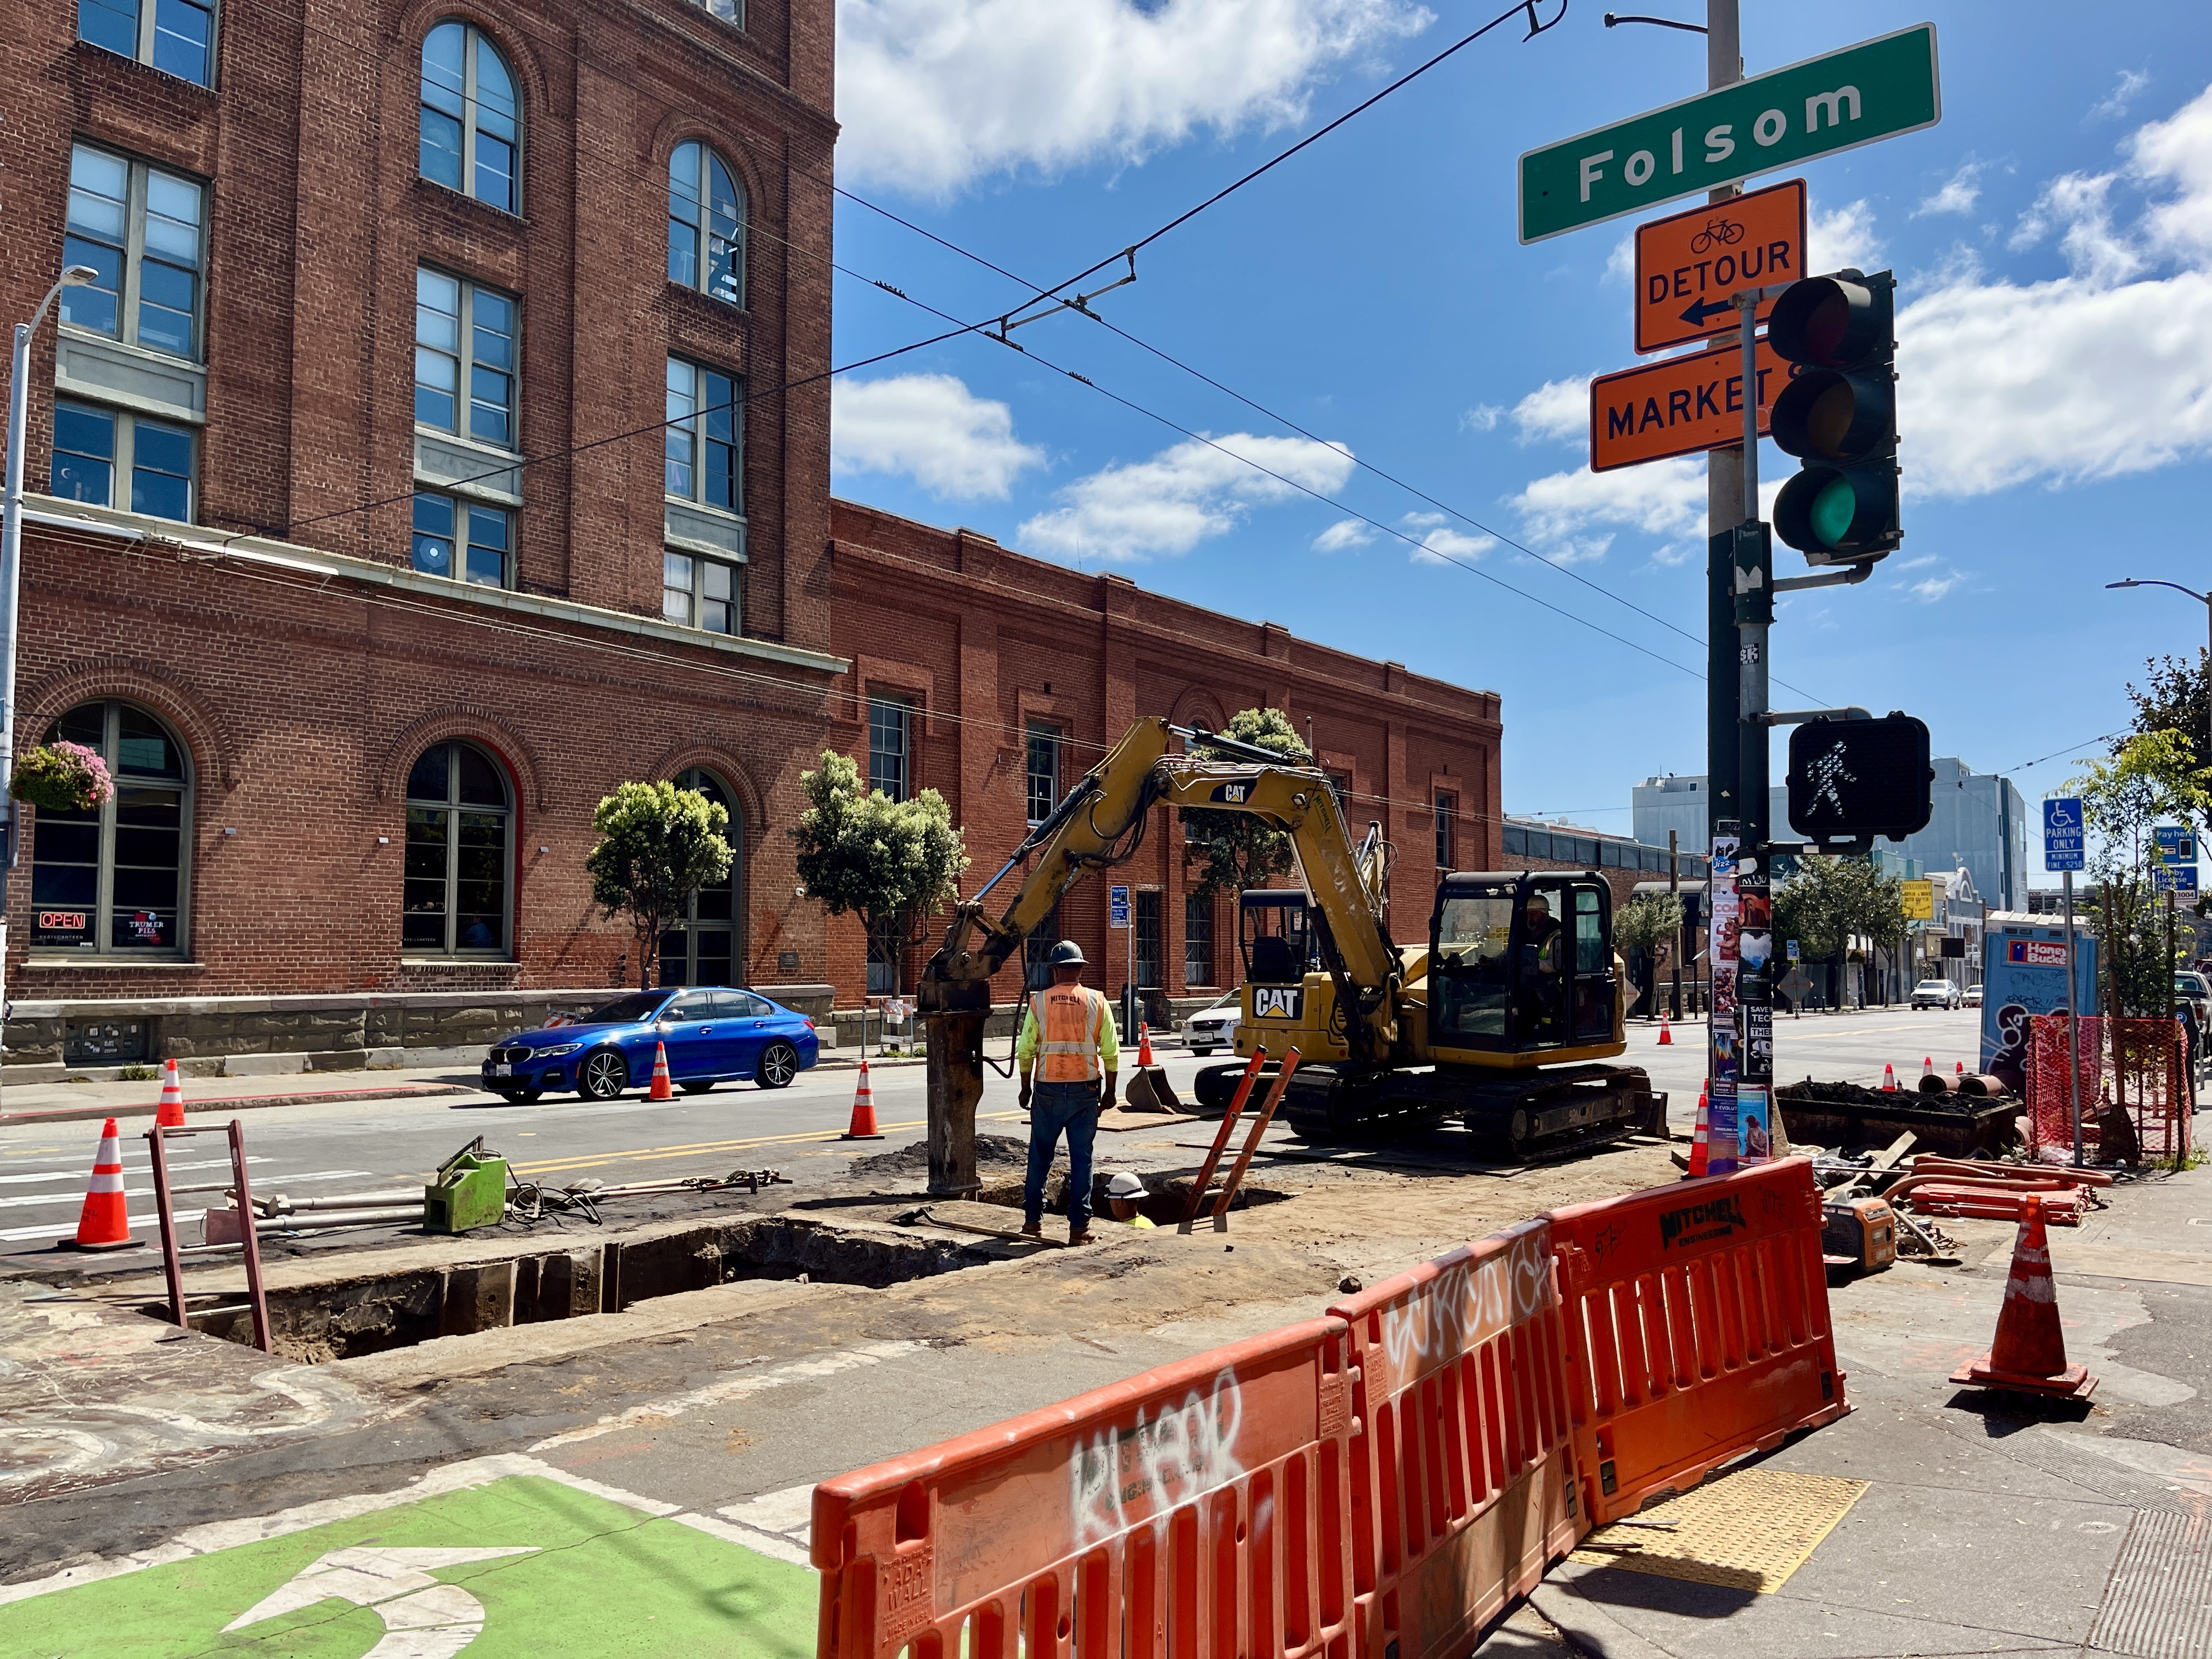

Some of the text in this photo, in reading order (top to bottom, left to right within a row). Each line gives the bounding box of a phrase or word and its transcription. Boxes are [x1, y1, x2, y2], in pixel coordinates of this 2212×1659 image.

[1579, 85, 1862, 202] Folsom
[1649, 241, 1790, 305] DETOUR
[1609, 368, 1773, 440] MARKET
[1225, 784, 1245, 803] CAT
[1313, 794, 1332, 834] MITCHELL
[2046, 826, 2081, 838] PARKING
[2157, 830, 2194, 839] Pay here
[2053, 838, 2075, 850] ONLY
[2174, 869, 2185, 877] by
[42, 913, 83, 927] OPEN
[2027, 942, 2067, 957] Honey
[2027, 952, 2067, 965] Bucke
[1051, 995, 1080, 1006] MITCHELL
[1256, 988, 1298, 1018] CAT
[1660, 1193, 1747, 1251] MITCHELL
[1678, 1224, 1733, 1248] ENGINEERING
[892, 1559, 923, 1590] ADA
[888, 1576, 928, 1611] WALL
